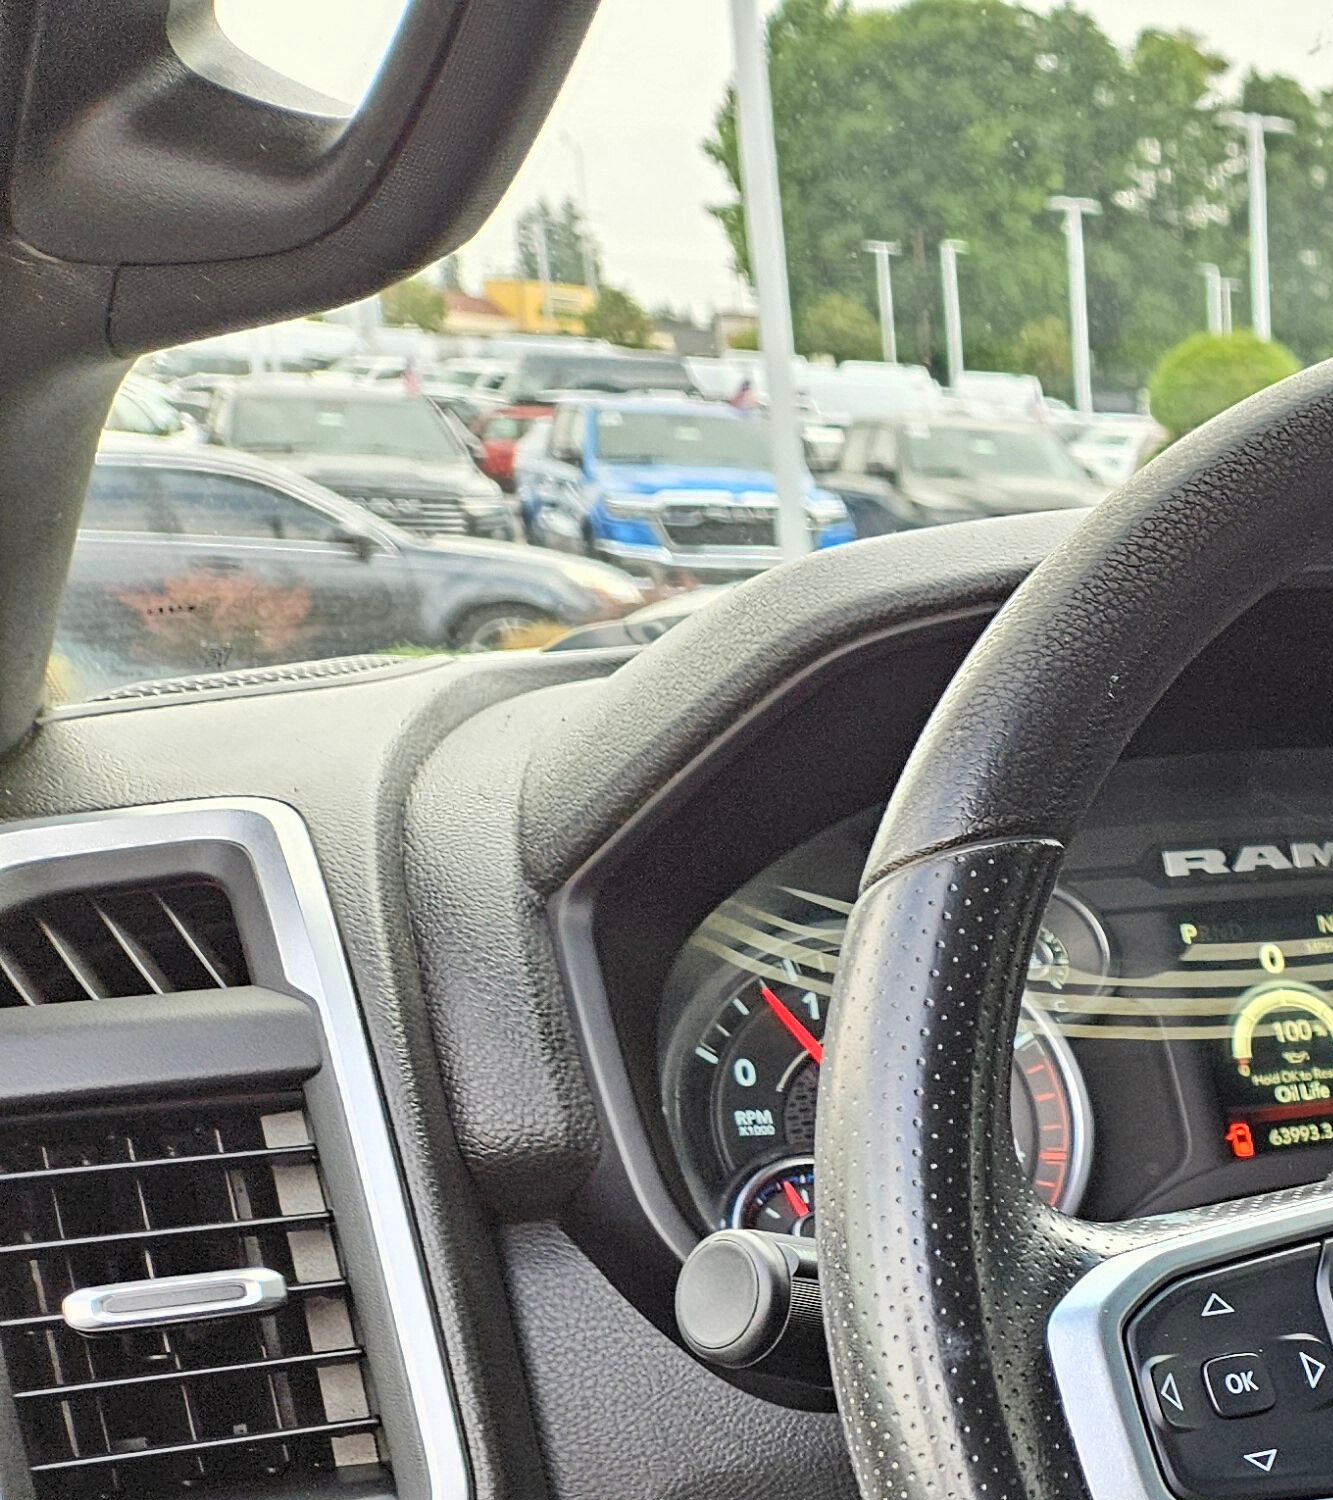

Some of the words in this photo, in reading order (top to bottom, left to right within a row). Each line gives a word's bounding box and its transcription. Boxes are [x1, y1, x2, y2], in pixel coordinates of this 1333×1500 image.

[1180, 923, 1197, 944] P
[1259, 943, 1285, 974] 0
[802, 991, 820, 1020] 1
[734, 1058, 756, 1087] 0
[1274, 1085, 1300, 1103] Oil
[1301, 1082, 1330, 1100] Life
[734, 1109, 774, 1126] RPM
[1269, 1122, 1333, 1146] 63993.3
[1225, 1370, 1259, 1395] OK
